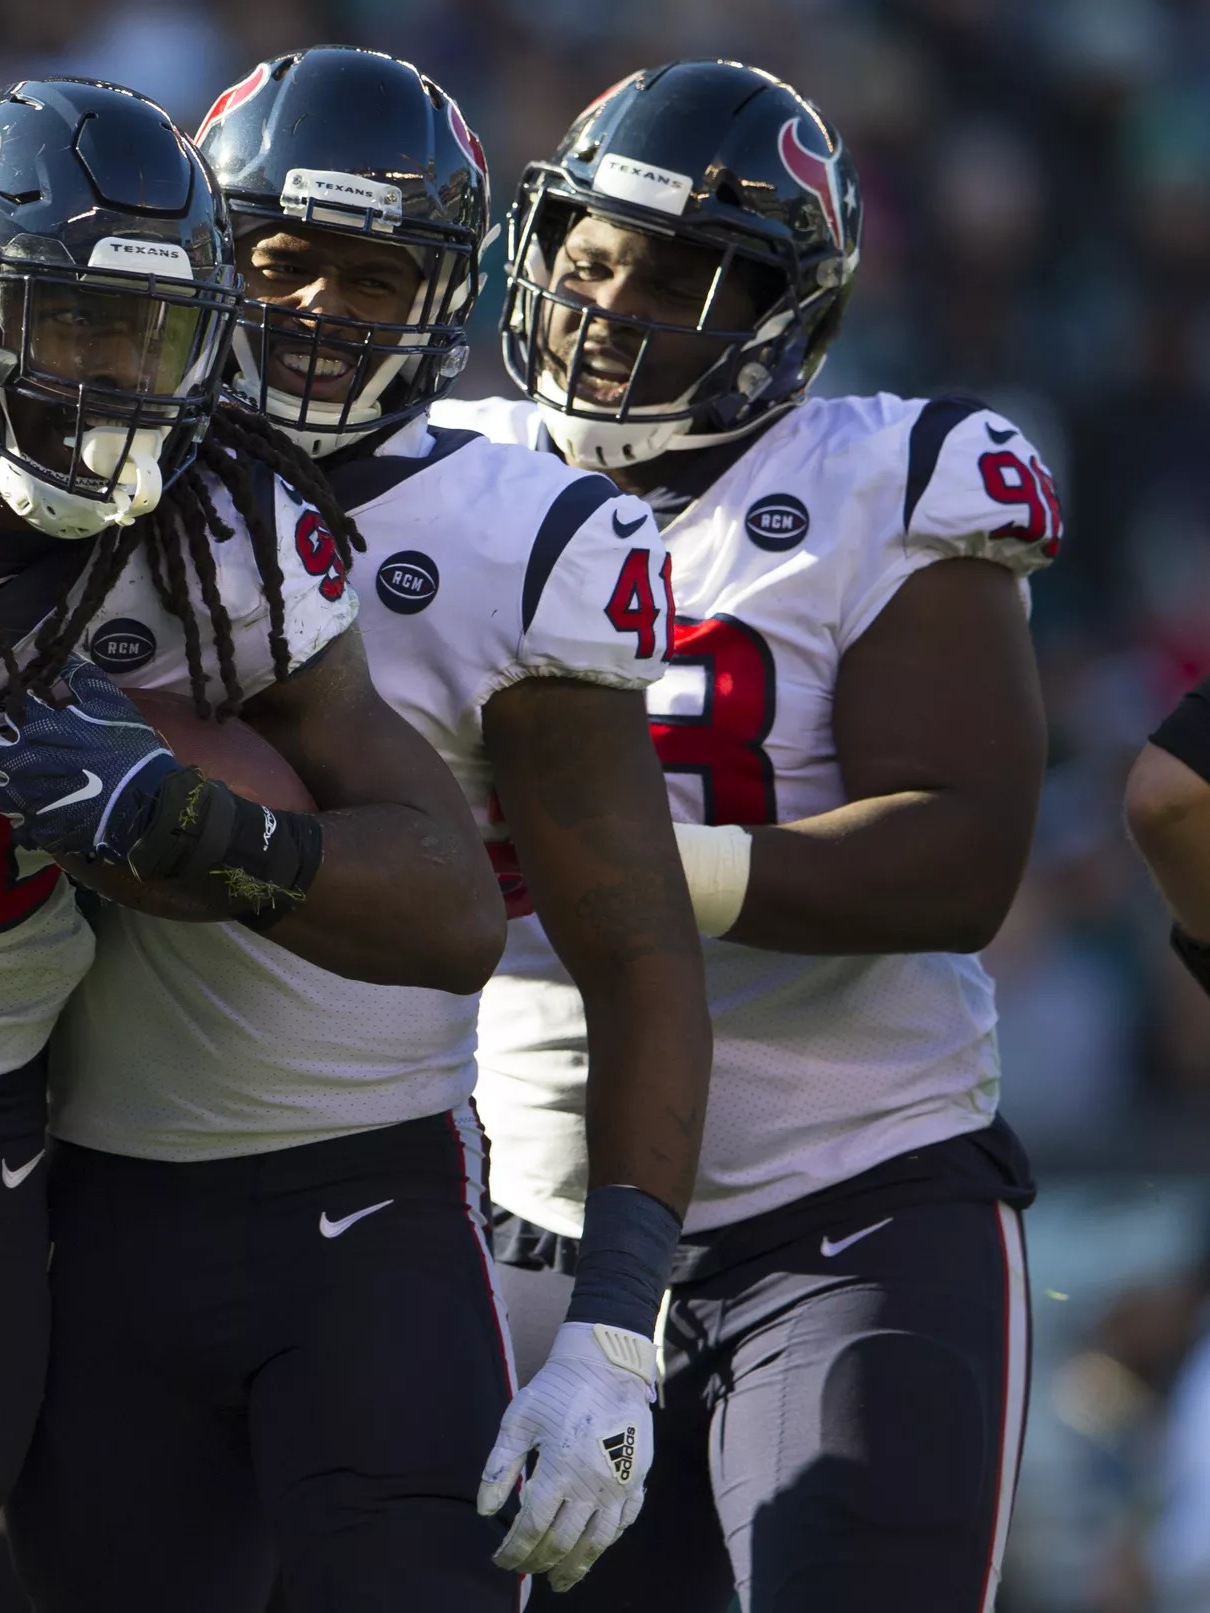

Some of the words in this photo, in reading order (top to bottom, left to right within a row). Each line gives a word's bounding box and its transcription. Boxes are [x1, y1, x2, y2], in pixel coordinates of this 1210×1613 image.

[610, 162, 683, 190] TEXANS
[315, 181, 374, 198] TEXANS
[110, 243, 180, 259] TEXANS
[761, 513, 794, 530] RCM
[392, 570, 424, 592] RCM
[108, 641, 140, 655] RCM
[620, 1426, 636, 1481] adidas
